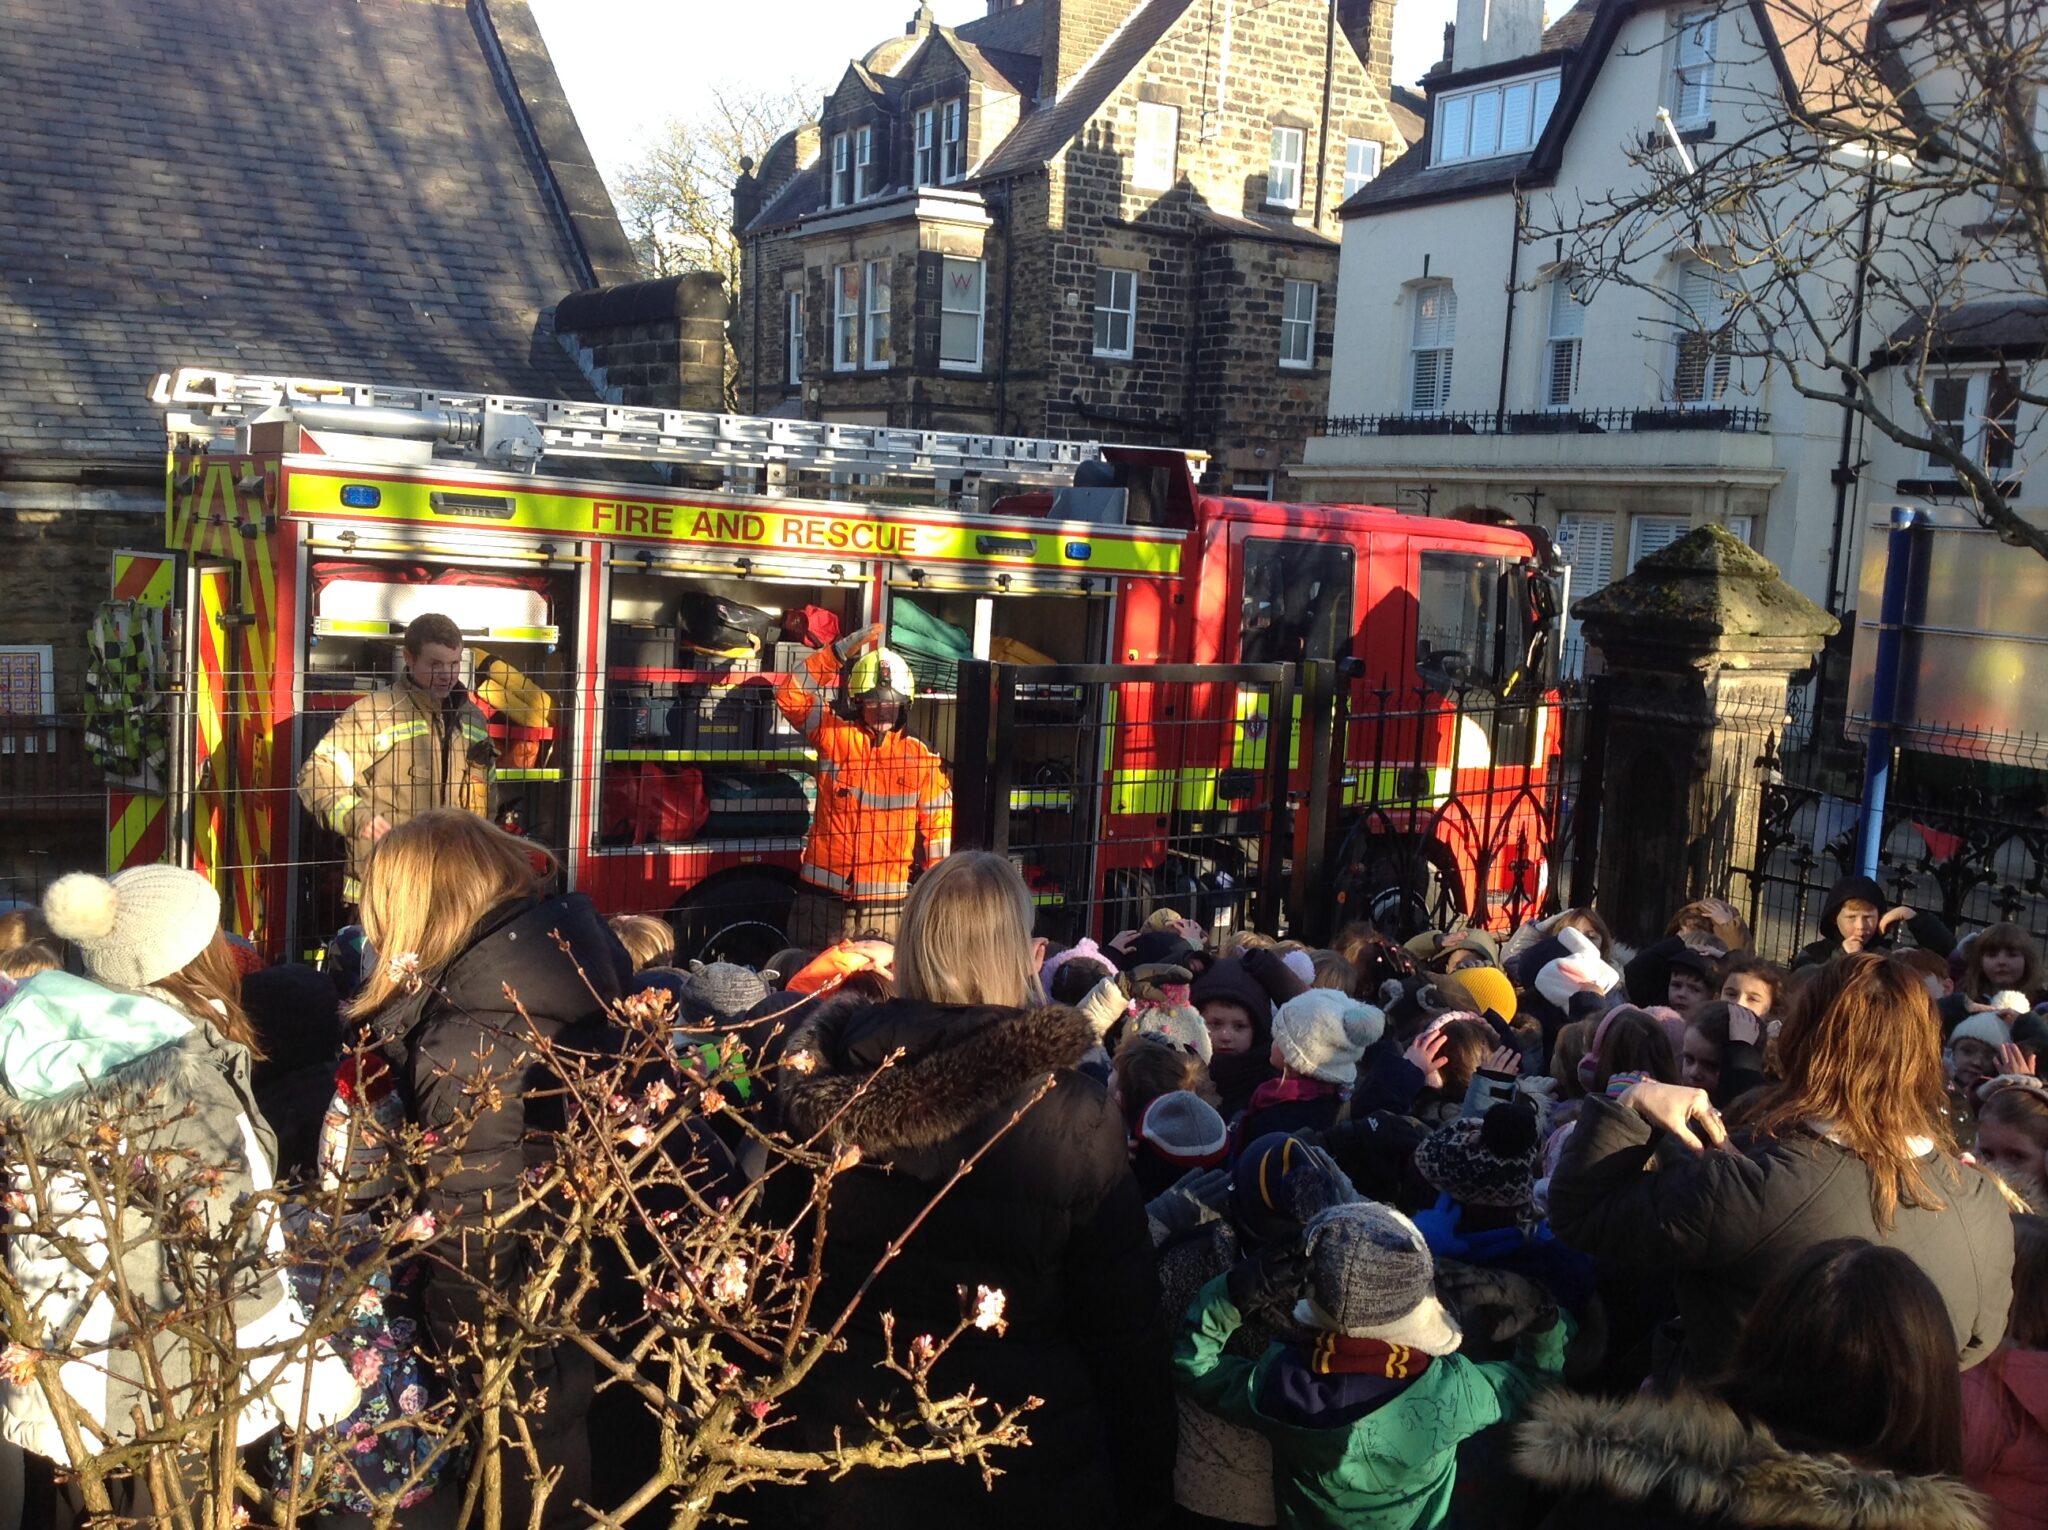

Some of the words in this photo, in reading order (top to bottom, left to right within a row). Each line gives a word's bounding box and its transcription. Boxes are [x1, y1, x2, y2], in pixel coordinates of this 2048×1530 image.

[951, 272, 972, 289] W
[592, 502, 674, 535] FIRE
[690, 511, 766, 542] AND
[782, 518, 917, 552] RESCUE
